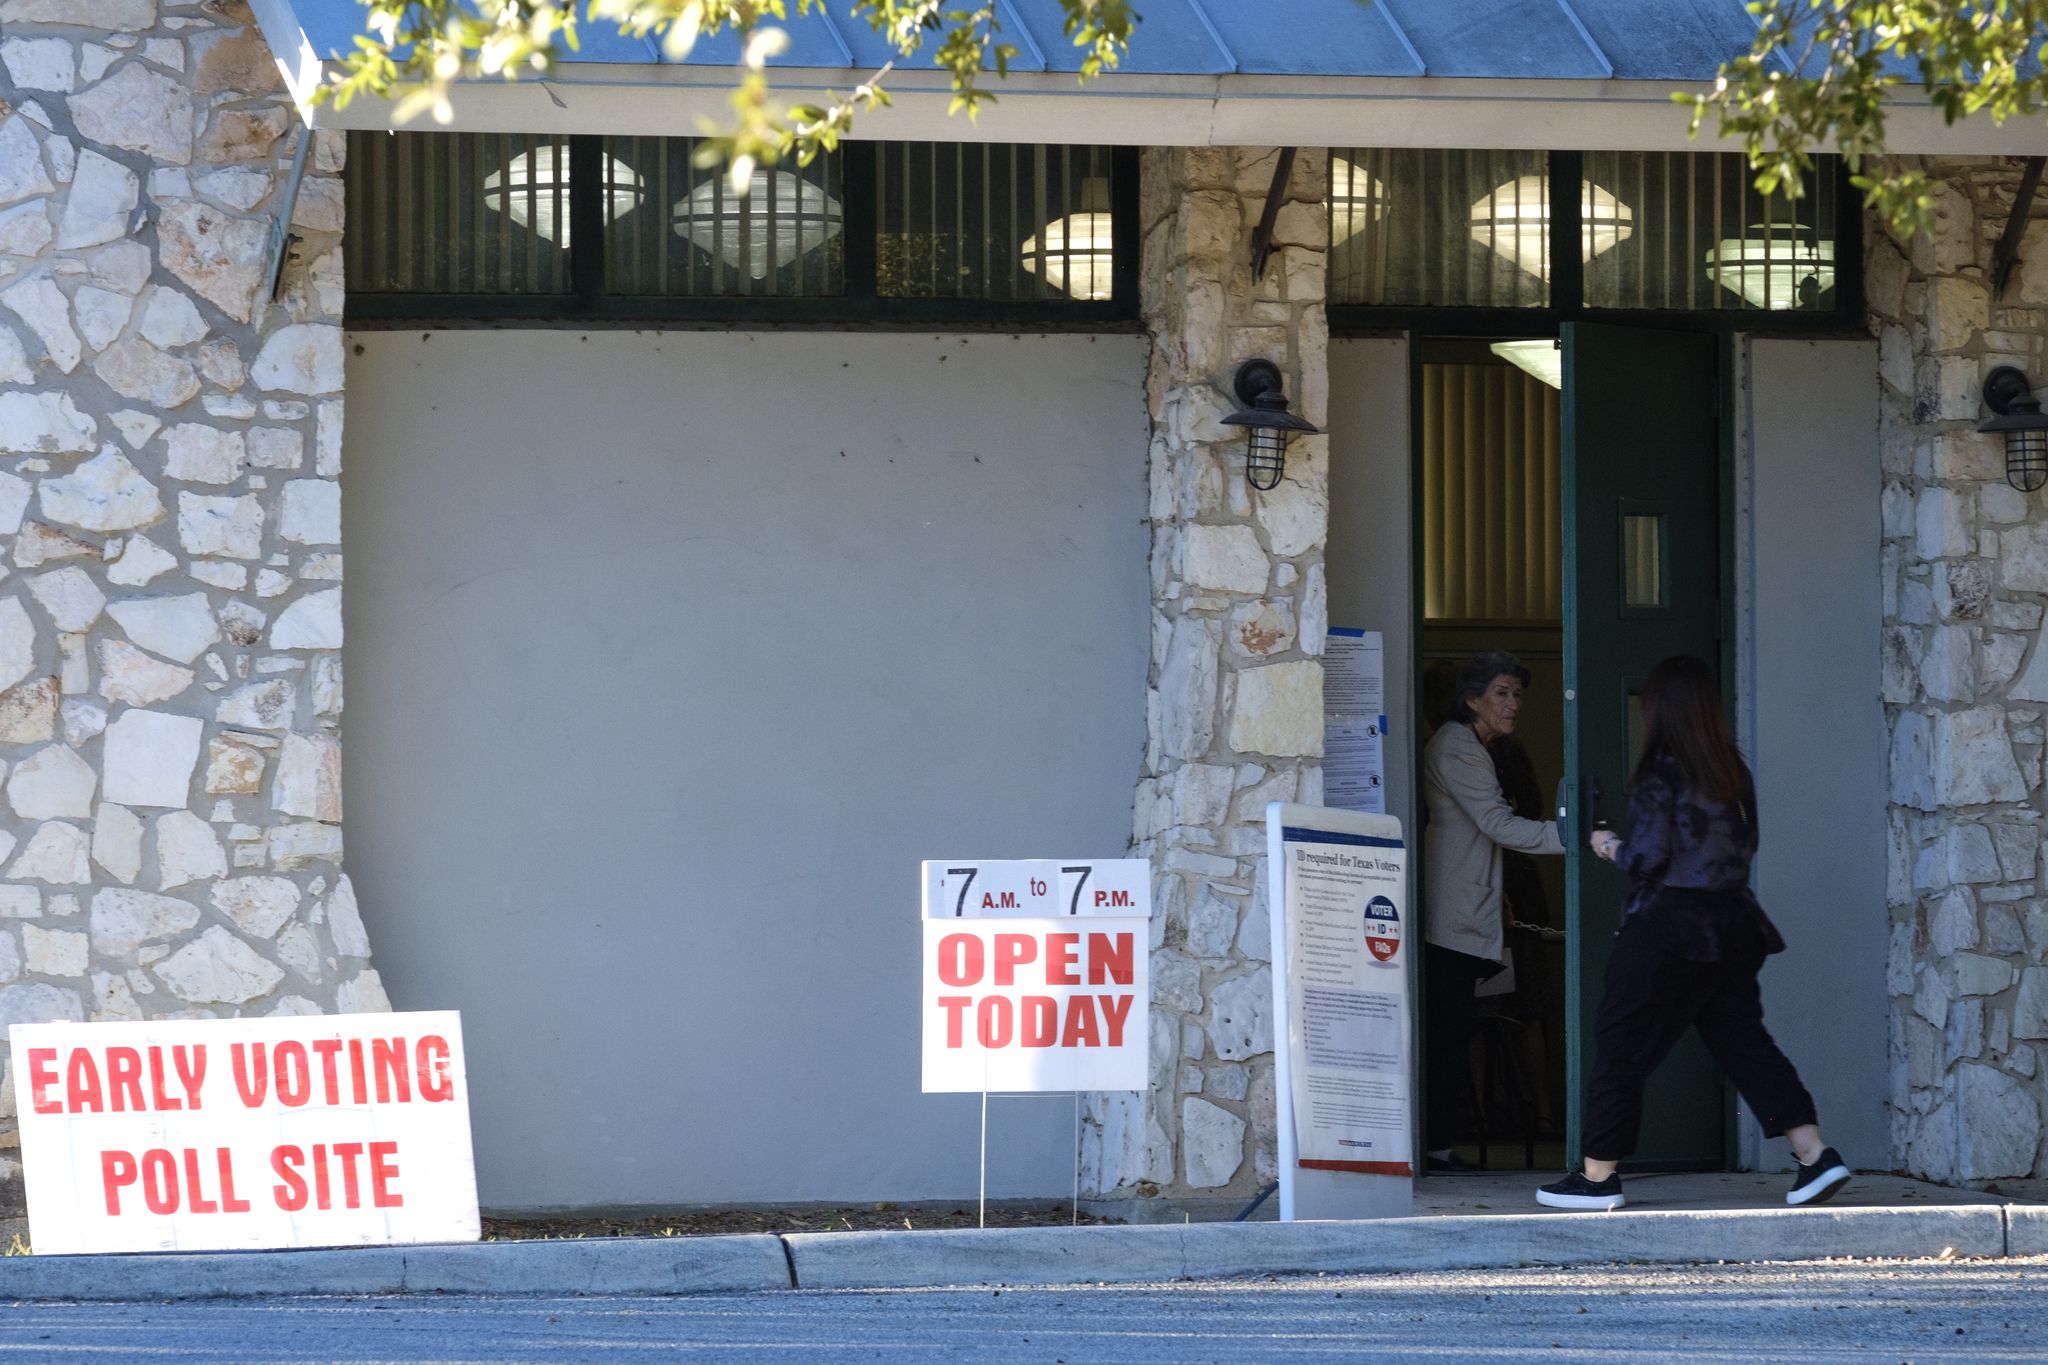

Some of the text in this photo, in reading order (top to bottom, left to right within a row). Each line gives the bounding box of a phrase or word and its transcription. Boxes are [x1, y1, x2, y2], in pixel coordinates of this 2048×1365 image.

[1296, 849, 1400, 872] ID required for Texas Voters
[947, 866, 1135, 917] 7 A.M. to 7 P.M.
[1370, 904, 1394, 917] VOTER
[1377, 923, 1386, 934] ID
[938, 932, 1134, 987] OPEN
[938, 995, 1135, 1048] TODAY
[28, 1035, 454, 1114] EARLY VOTING
[100, 1141, 404, 1216] POLL SITE
